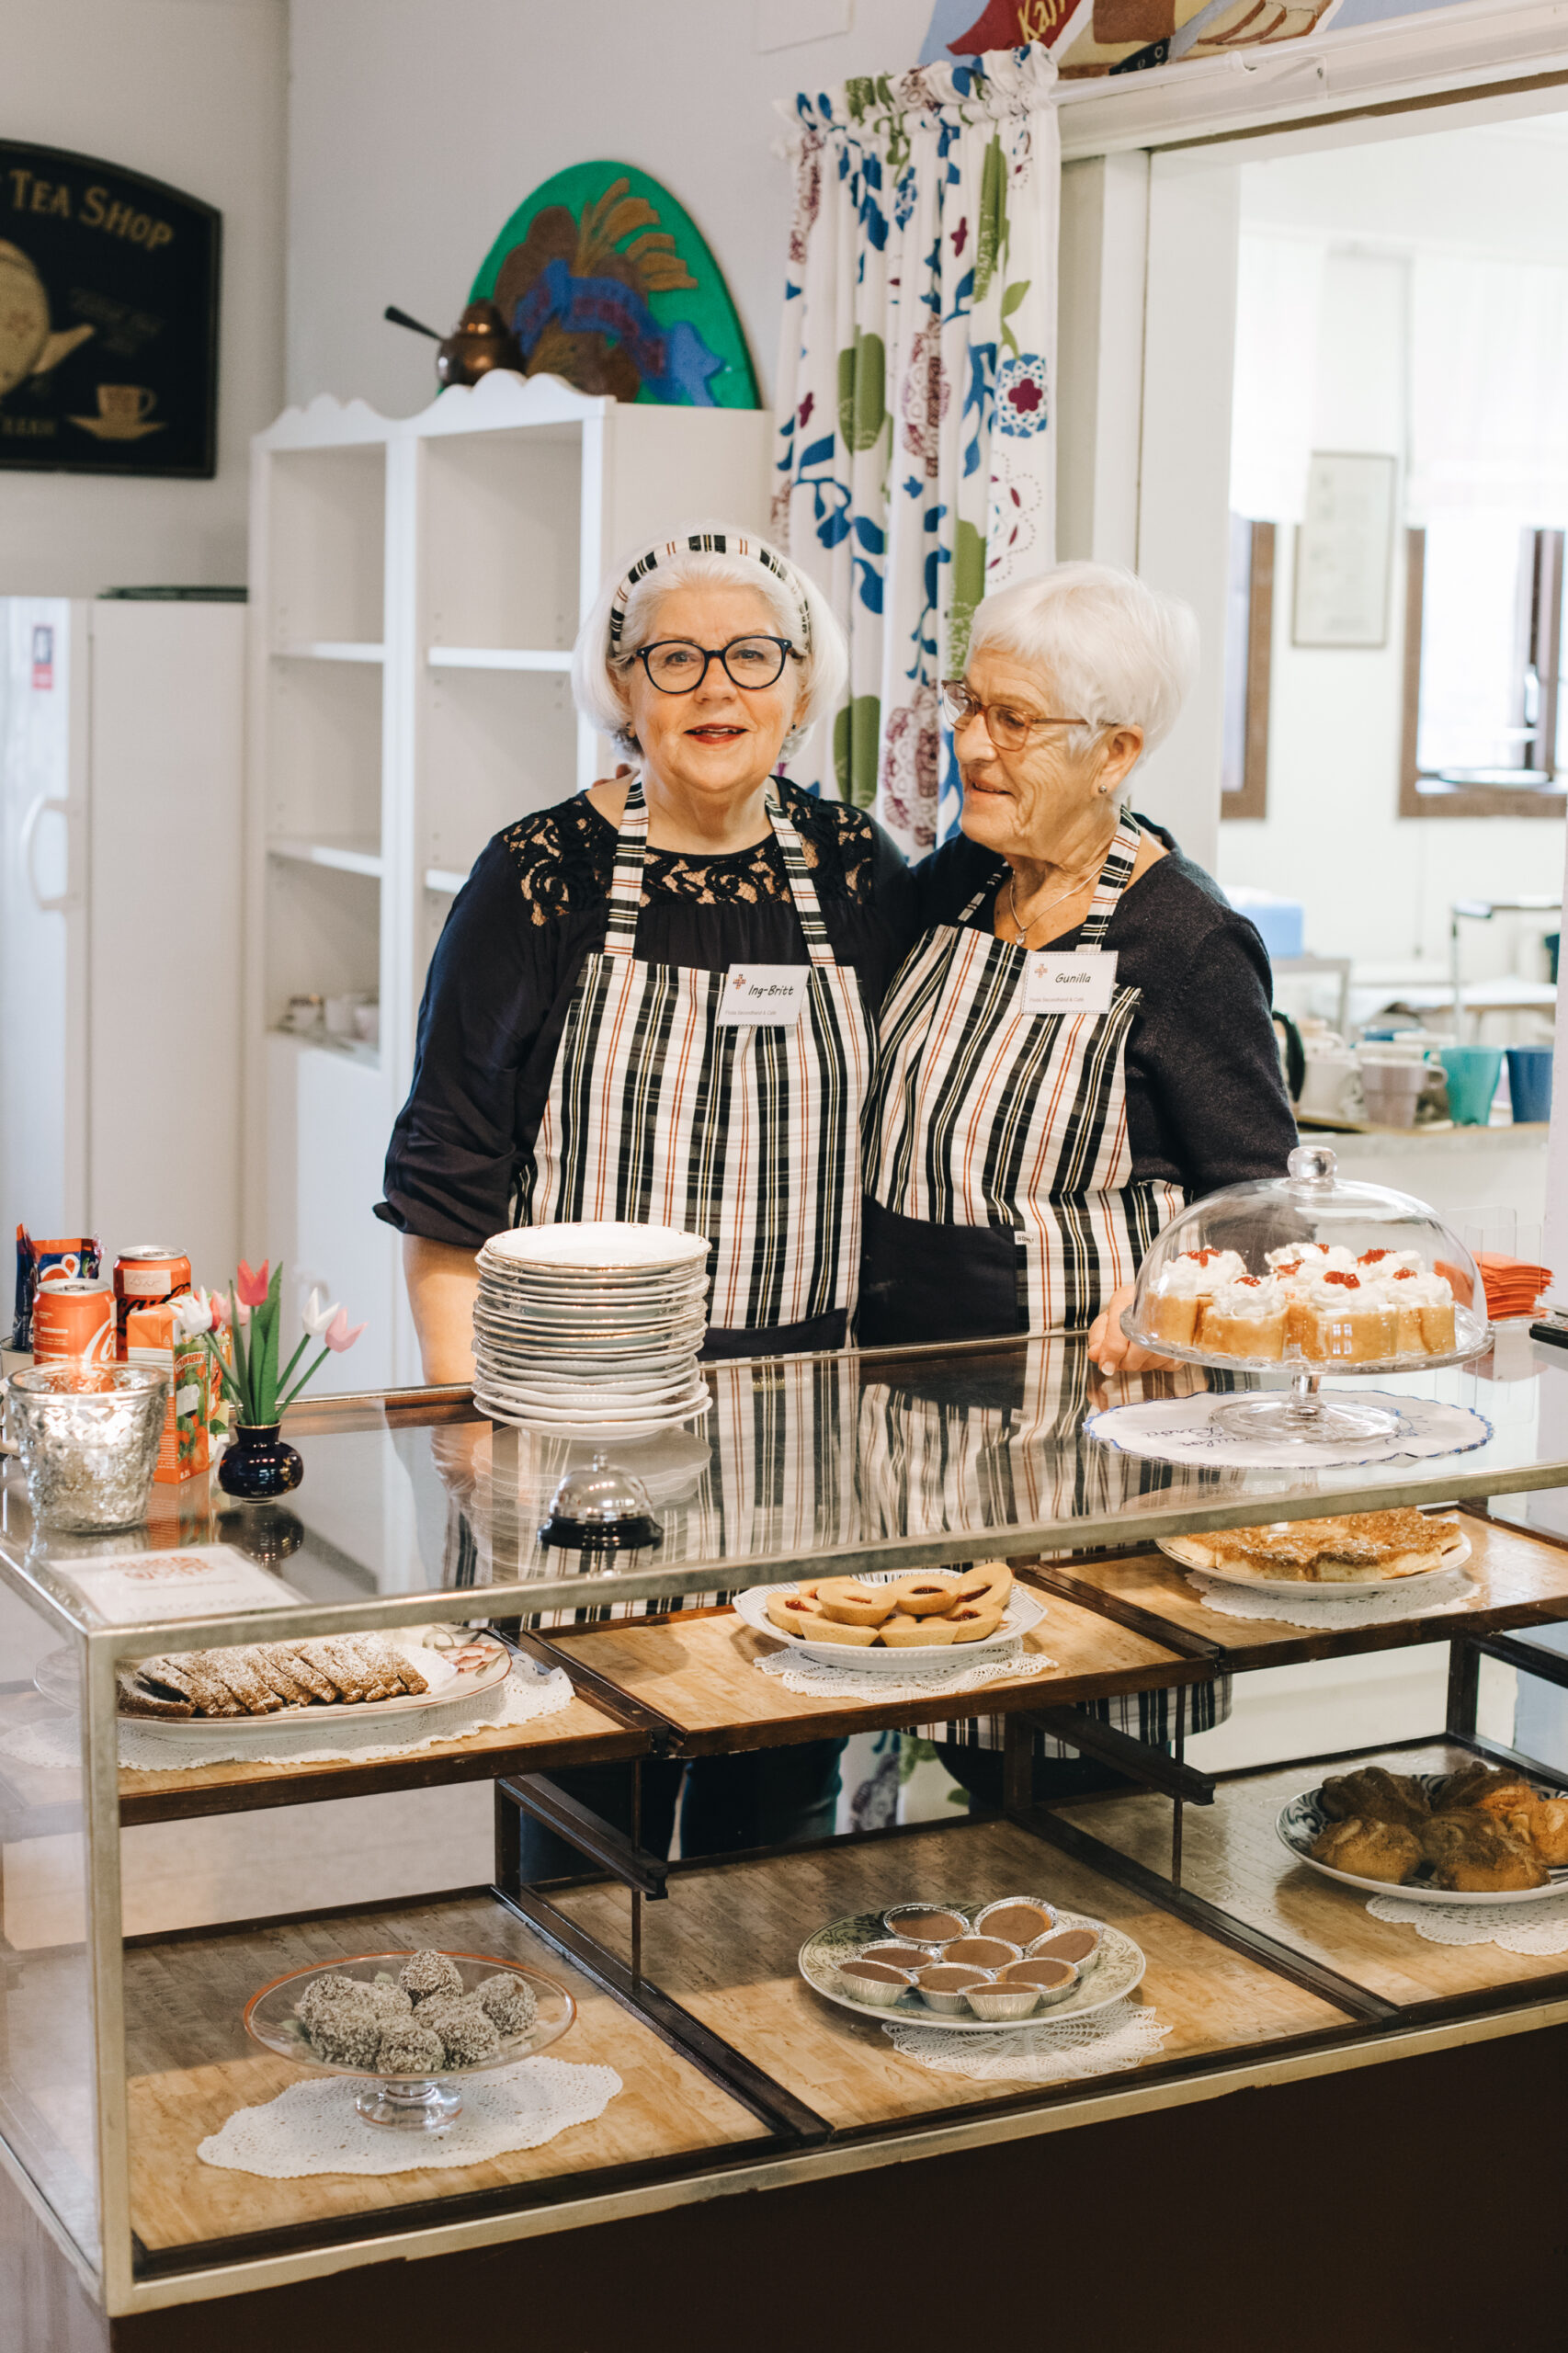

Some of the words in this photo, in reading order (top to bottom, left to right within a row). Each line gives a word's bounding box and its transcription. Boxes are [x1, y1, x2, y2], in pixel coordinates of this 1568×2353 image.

[9, 169, 70, 218] TEA
[79, 186, 174, 250] SHOP
[1055, 972, 1091, 983] Gunilla
[748, 984, 794, 998] Ing-Britt
